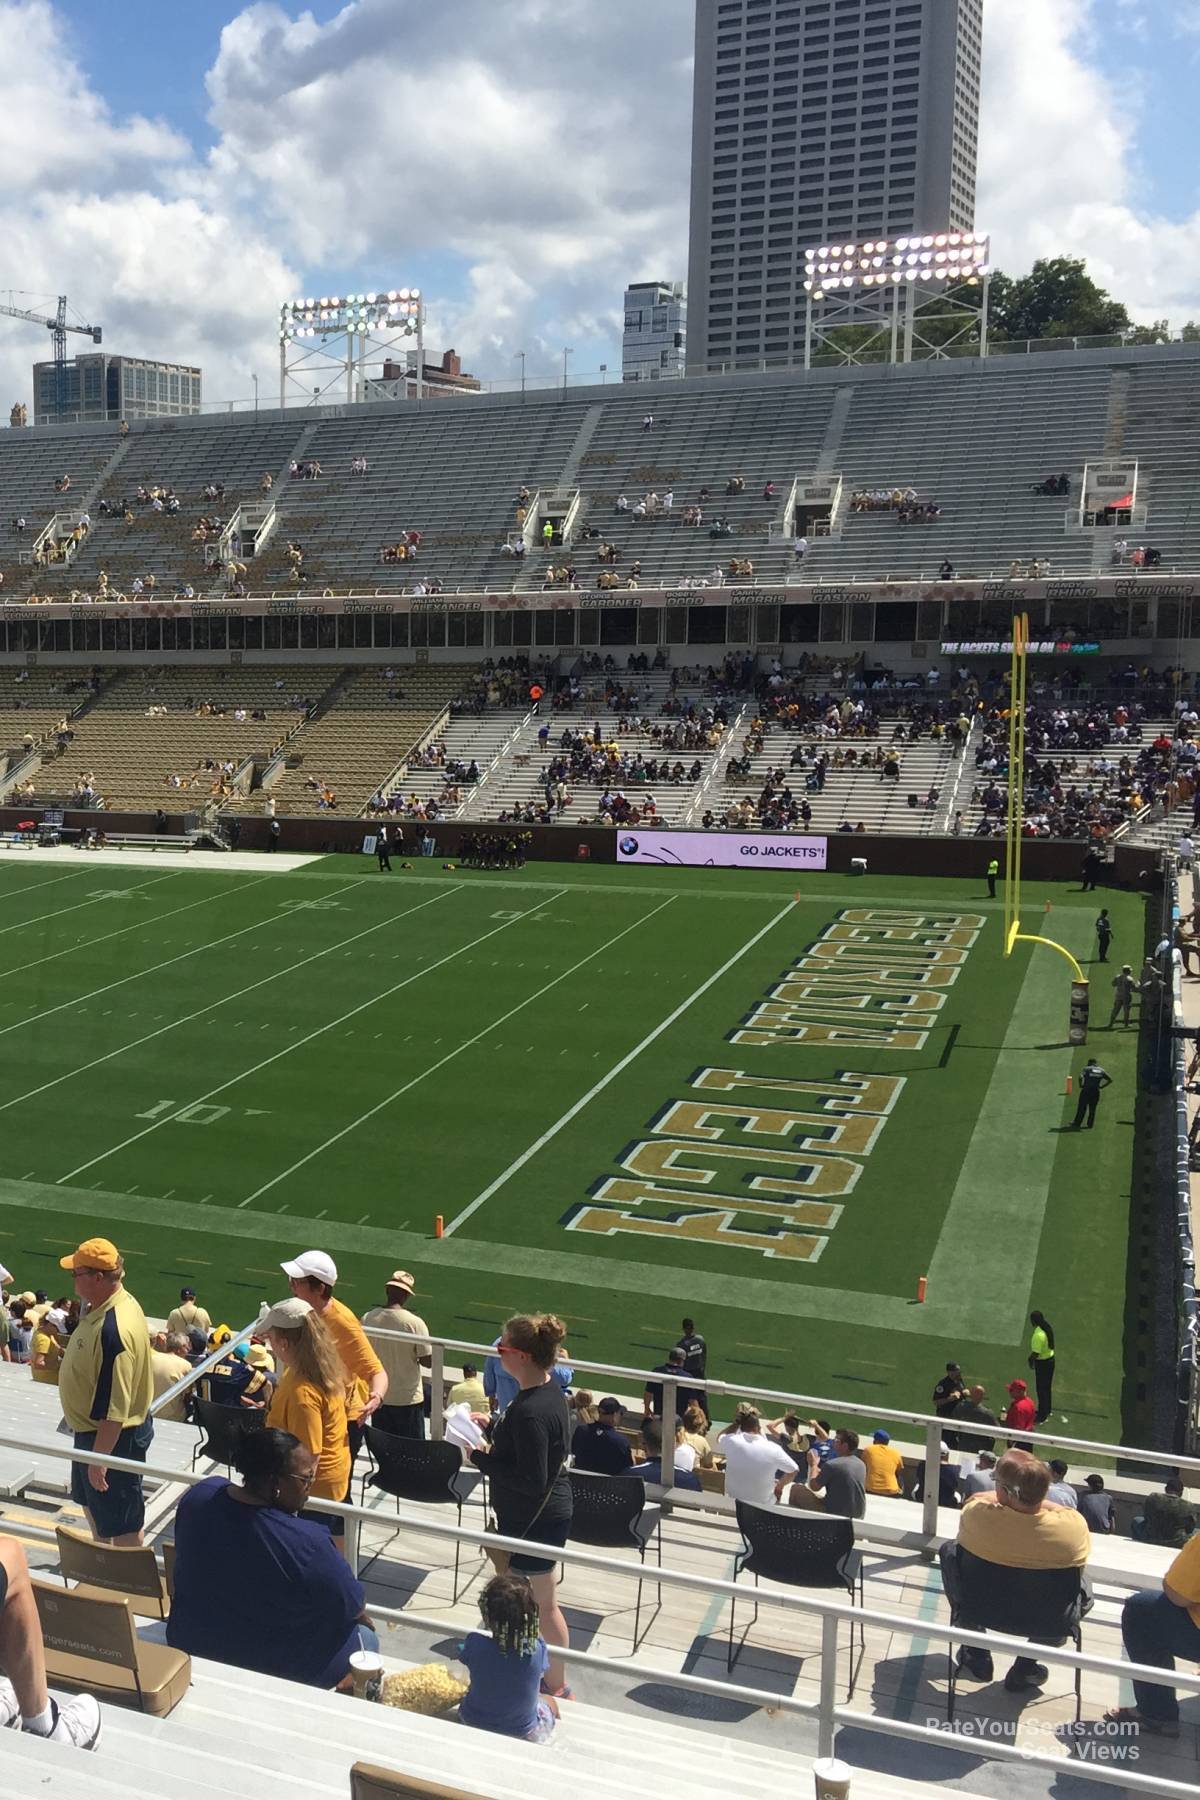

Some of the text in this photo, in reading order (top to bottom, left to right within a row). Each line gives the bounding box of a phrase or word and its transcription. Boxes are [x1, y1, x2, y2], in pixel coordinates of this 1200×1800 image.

[983, 583, 1005, 591] RAY
[1047, 581, 1084, 589] RANDY
[1115, 579, 1136, 588] PAT
[666, 590, 697, 599] BOBBY
[731, 588, 761, 597] LARRY
[812, 586, 844, 595] BOBBY
[983, 589, 1027, 599] BECK
[1047, 587, 1098, 597] RHINO
[1115, 586, 1194, 596] SWILLING
[579, 592, 613, 600] GEORGE
[731, 594, 786, 604] MORRIS
[812, 592, 871, 603] GASTON
[411, 602, 481, 612] ALEXANDER
[579, 599, 643, 608] GARDNER
[666, 597, 705, 607] DODD
[191, 608, 242, 616] HEISMAN
[267, 606, 326, 614] STRUPPER
[343, 604, 394, 614] FINCHER
[3, 612, 50, 620] FLOWERS
[941, 642, 959, 654] THE
[959, 642, 1000, 654] JACKETS
[1040, 642, 1055, 654] ON
[740, 845, 759, 856] GO
[277, 899, 341, 909] 20
[490, 910, 552, 921] 10
[724, 908, 988, 1051] GEORGIA
[134, 1100, 232, 1125] 10
[559, 1066, 908, 1264] TECH
